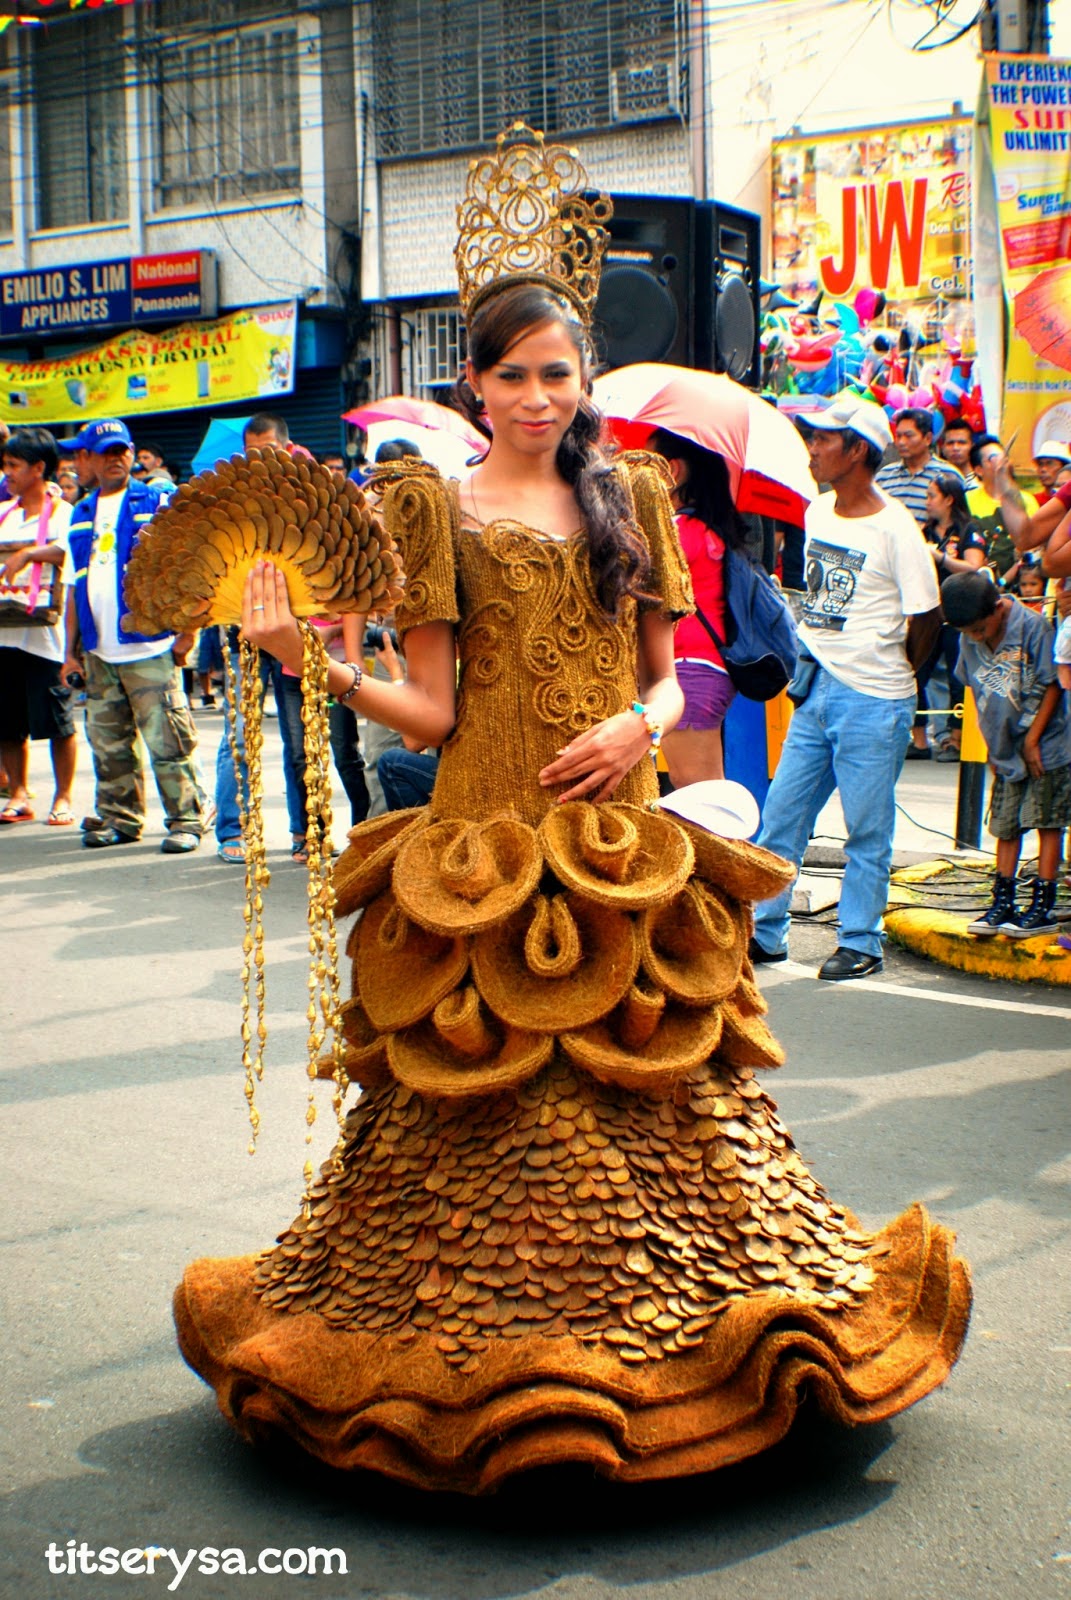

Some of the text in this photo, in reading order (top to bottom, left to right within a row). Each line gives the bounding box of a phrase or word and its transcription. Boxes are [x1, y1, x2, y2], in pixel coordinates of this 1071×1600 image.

[990, 84, 1018, 104] THE
[1004, 131, 1071, 152] UNLIMIT
[820, 178, 928, 296] JW
[137, 258, 198, 281] National
[2, 264, 126, 305] EMILIO S. LIM
[21, 298, 109, 328] APPLIANCES
[134, 292, 201, 313] Panasonic
[136, 320, 241, 355] SPECIAL
[129, 343, 227, 369] EVERYDAY
